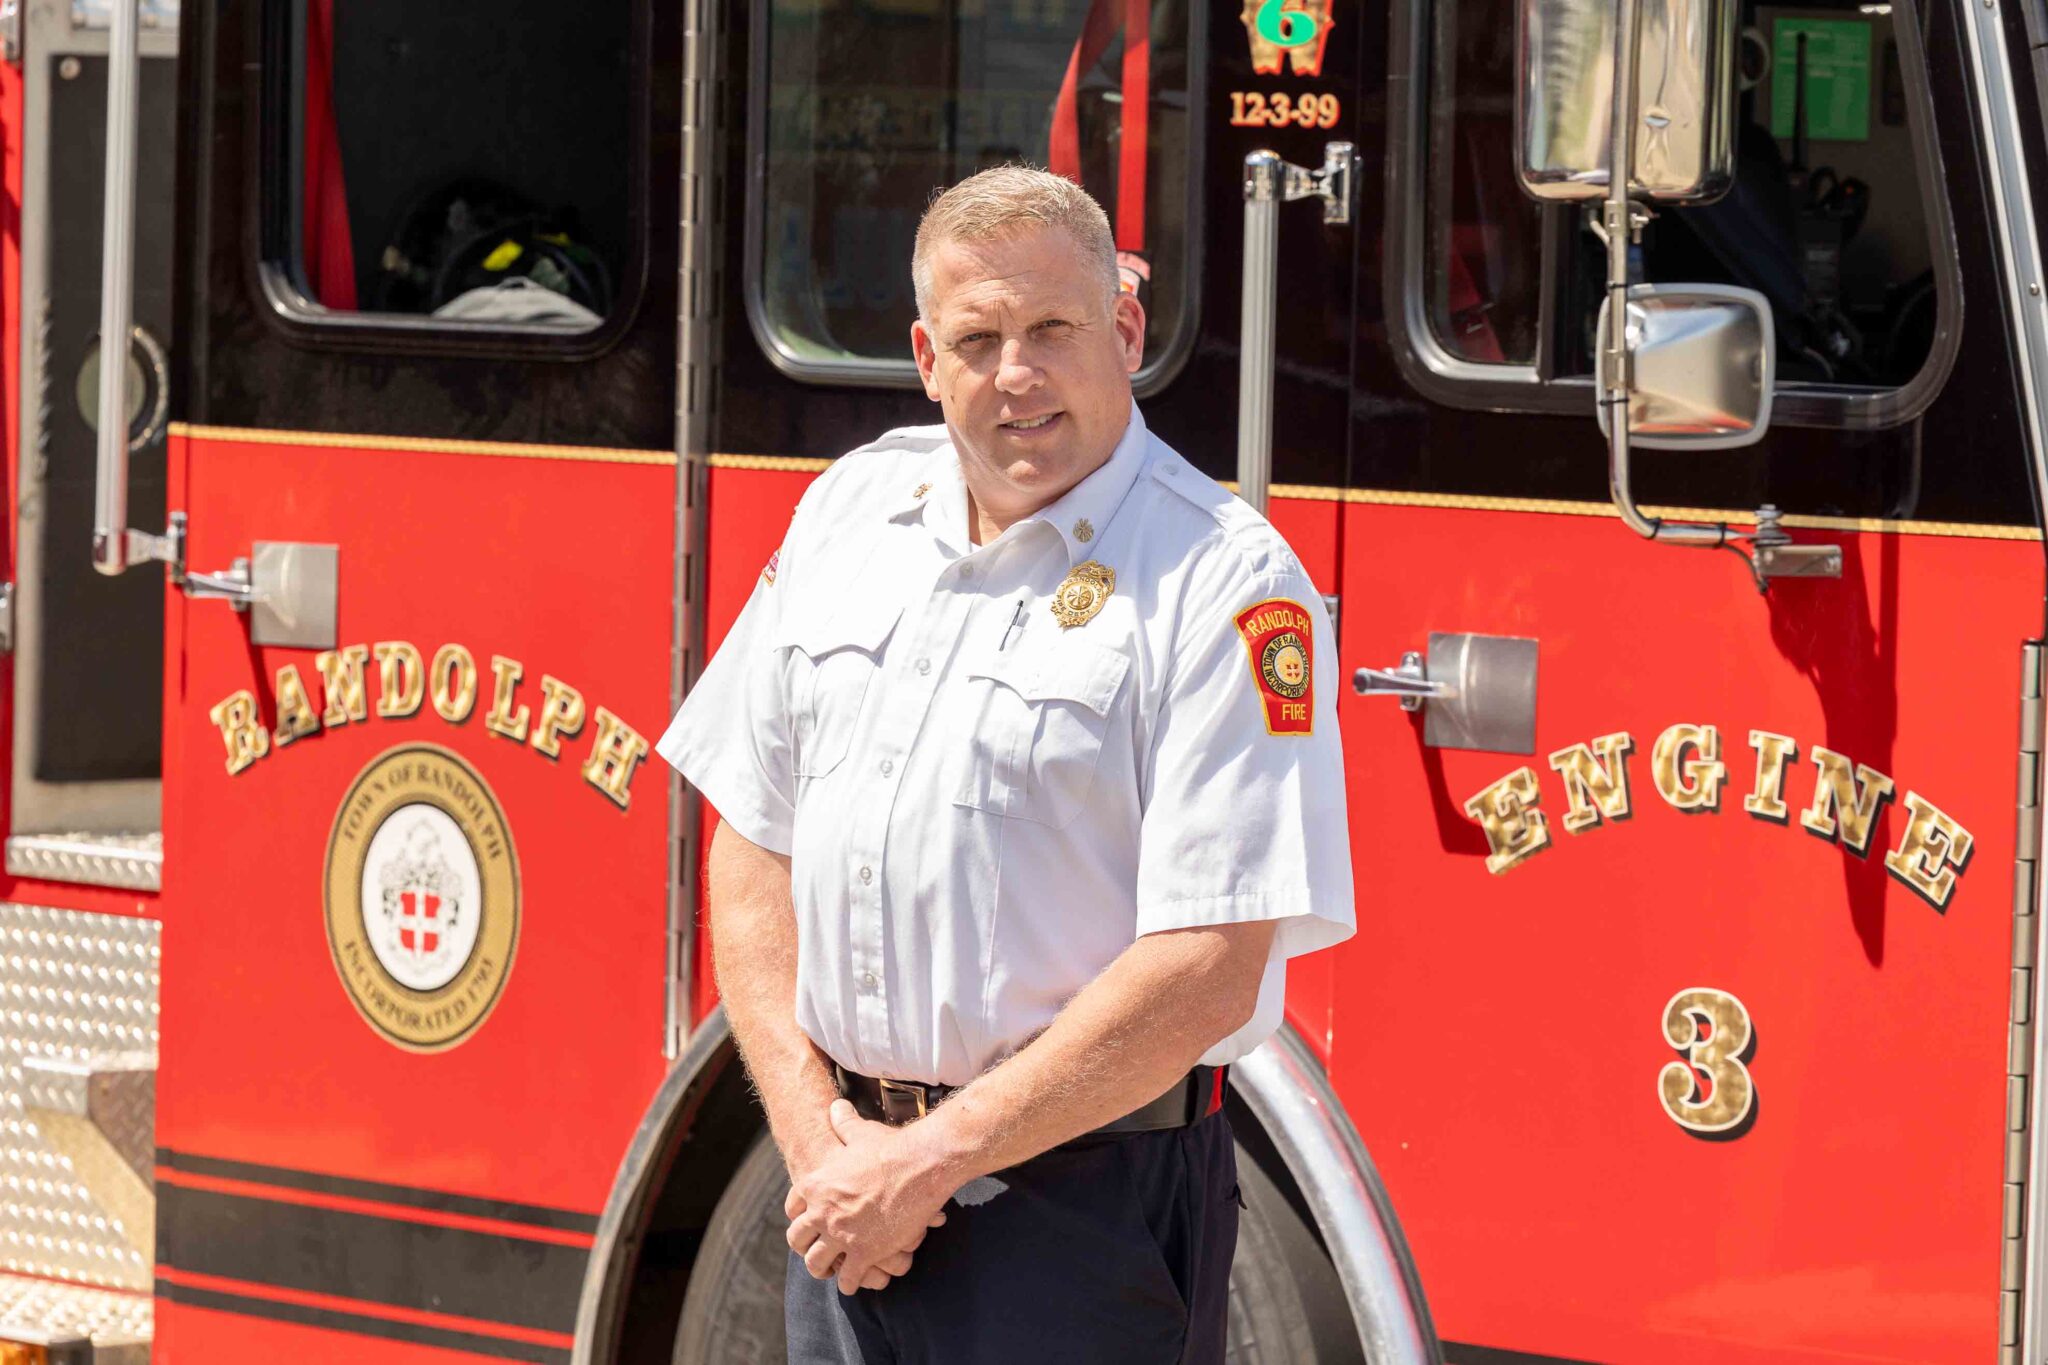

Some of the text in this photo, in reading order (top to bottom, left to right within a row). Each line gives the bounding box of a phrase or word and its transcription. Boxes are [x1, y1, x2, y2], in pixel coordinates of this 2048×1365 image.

[1256, 0, 1317, 47] 6
[1230, 92, 1341, 129] 12-3-99
[1246, 610, 1309, 637] RANDOLPH
[1264, 645, 1277, 667] TOWN
[1272, 637, 1283, 649] OF
[210, 641, 648, 809] RANDOLPH
[1282, 703, 1307, 721] FIRE
[344, 763, 502, 860] TOWN OF RANDOLPH
[1465, 724, 1975, 910] ENGINE
[345, 941, 467, 1030] INCORPORATED
[1658, 987, 1755, 1136] 3
